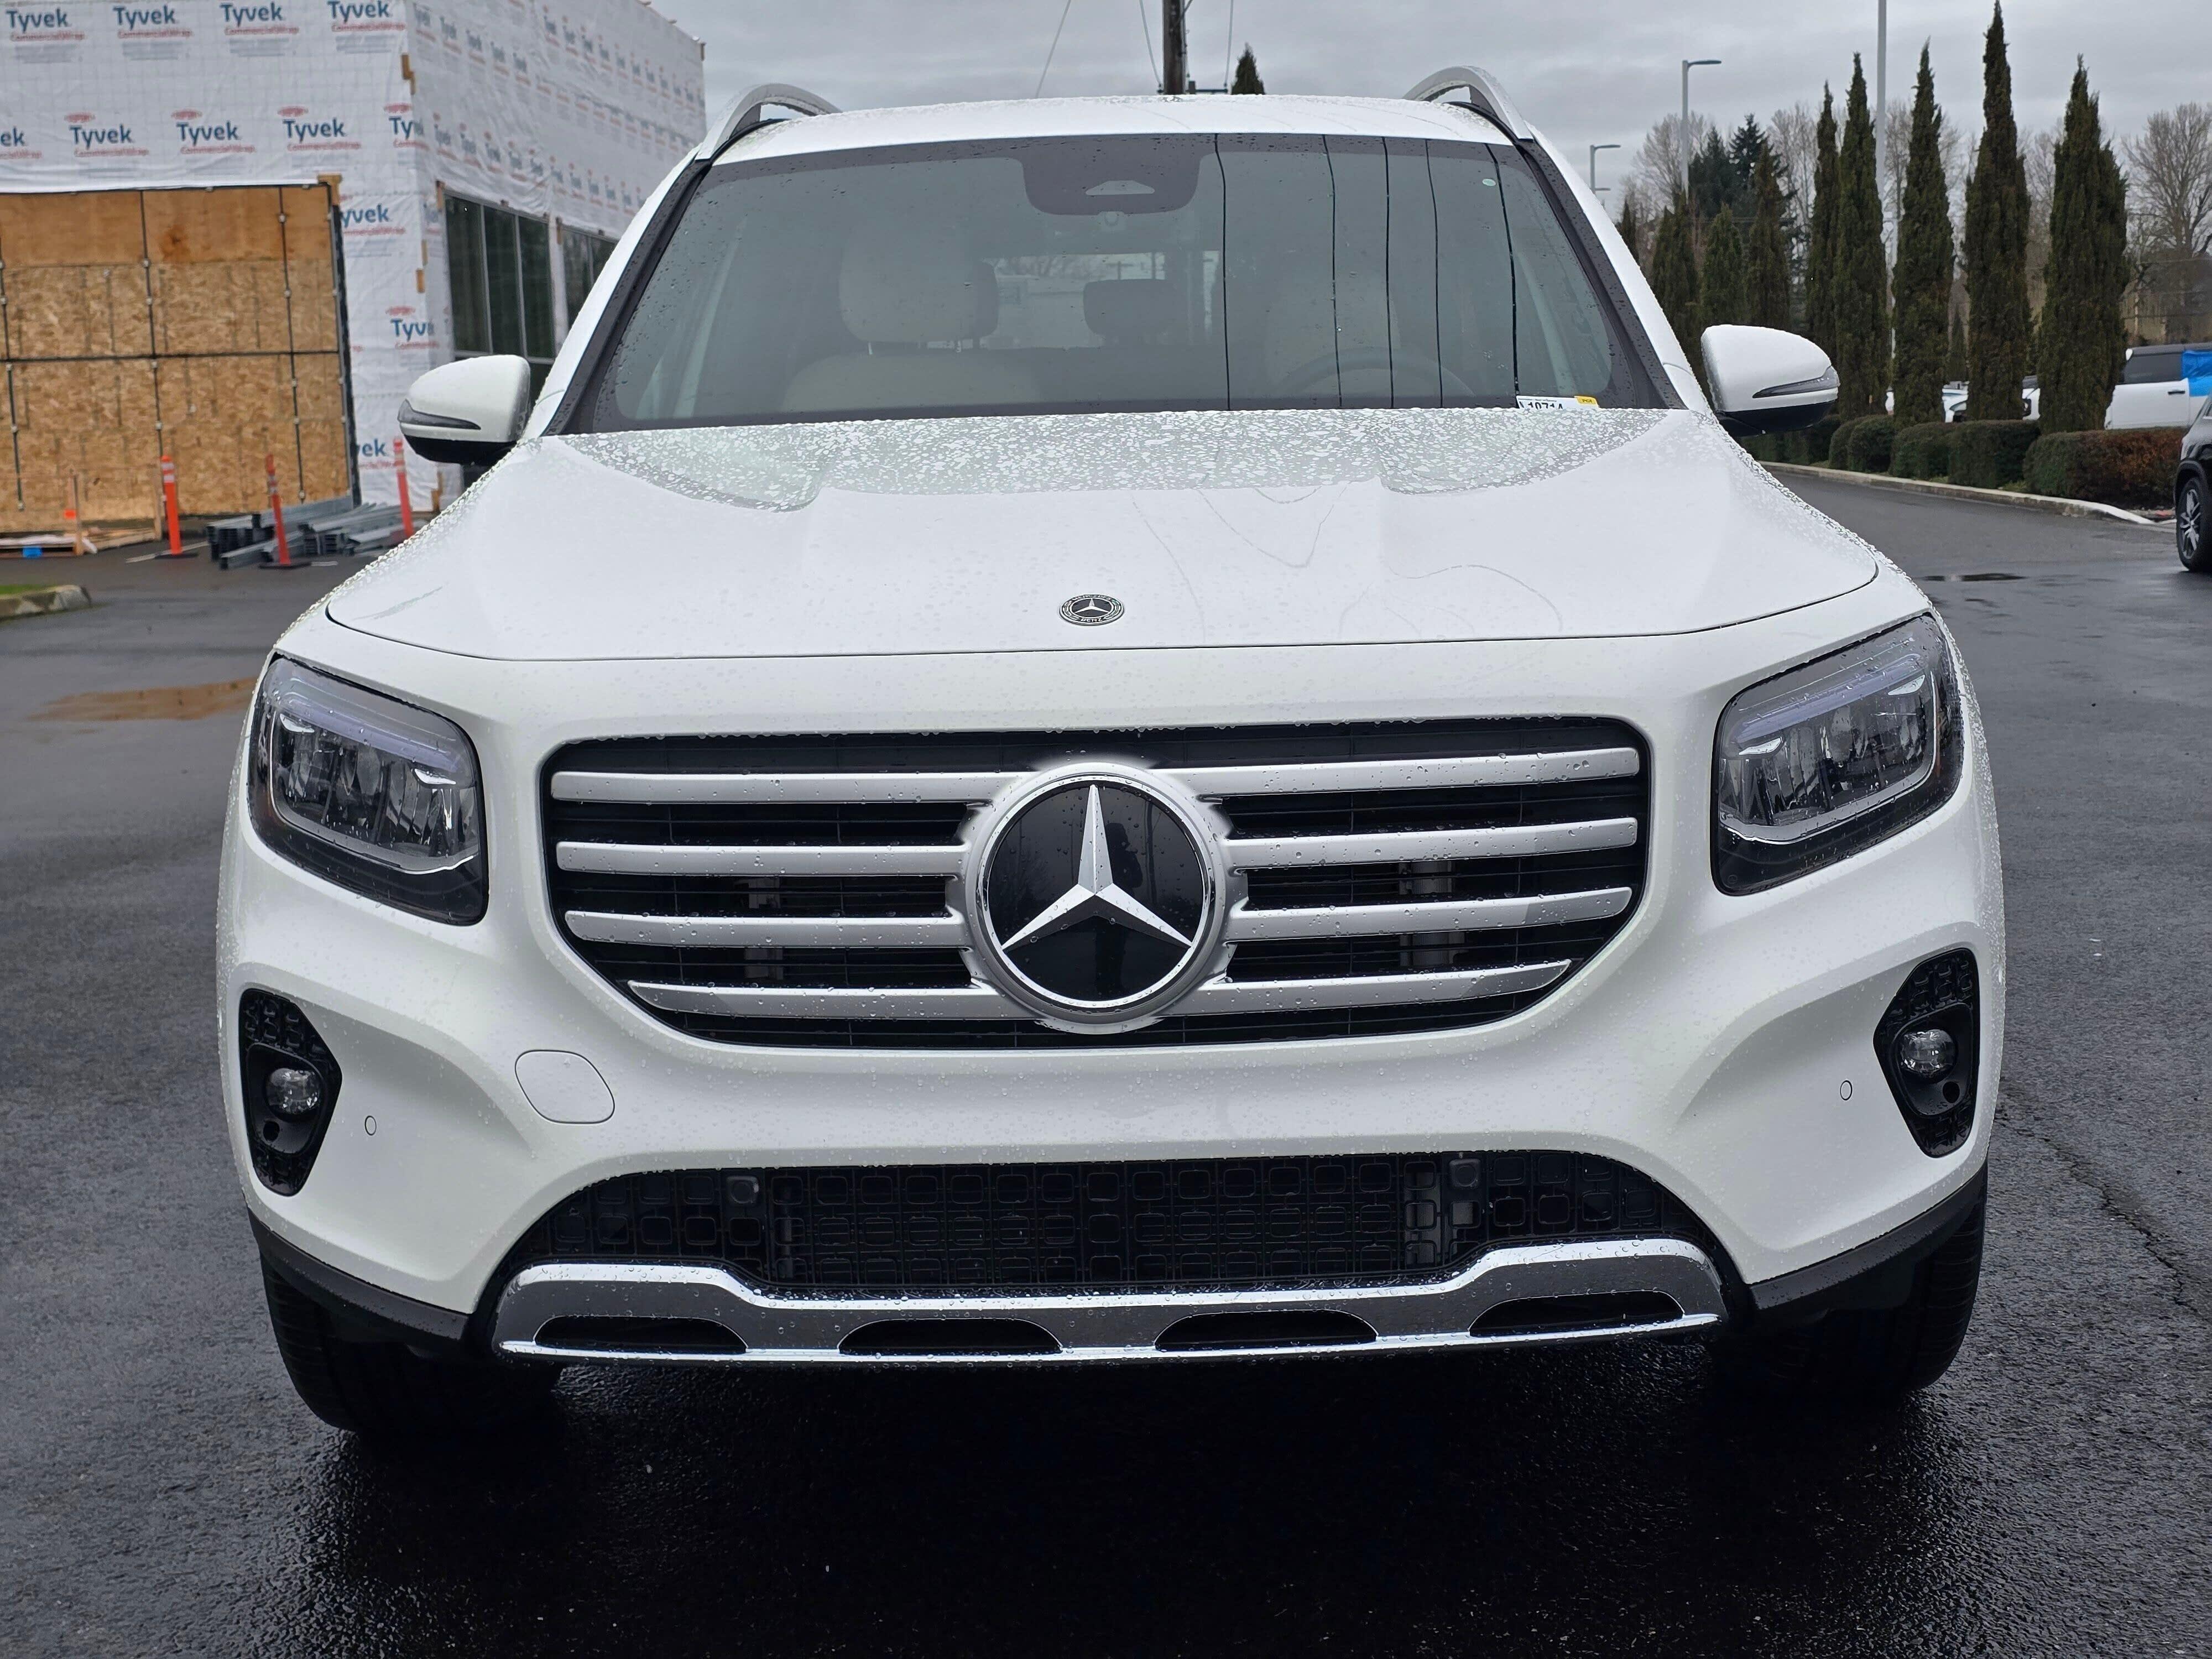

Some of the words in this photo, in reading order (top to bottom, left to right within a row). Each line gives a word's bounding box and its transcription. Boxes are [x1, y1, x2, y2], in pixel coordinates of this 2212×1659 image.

[6, 7, 69, 33] Tyvek
[113, 4, 176, 31] Tyvek
[220, 1, 283, 27] Tyvek
[327, 0, 390, 23] Tyvek
[69, 123, 132, 150] Tyvek
[176, 120, 239, 146] Tyvek
[283, 117, 346, 143] Tyvek
[341, 204, 389, 228] yvek
